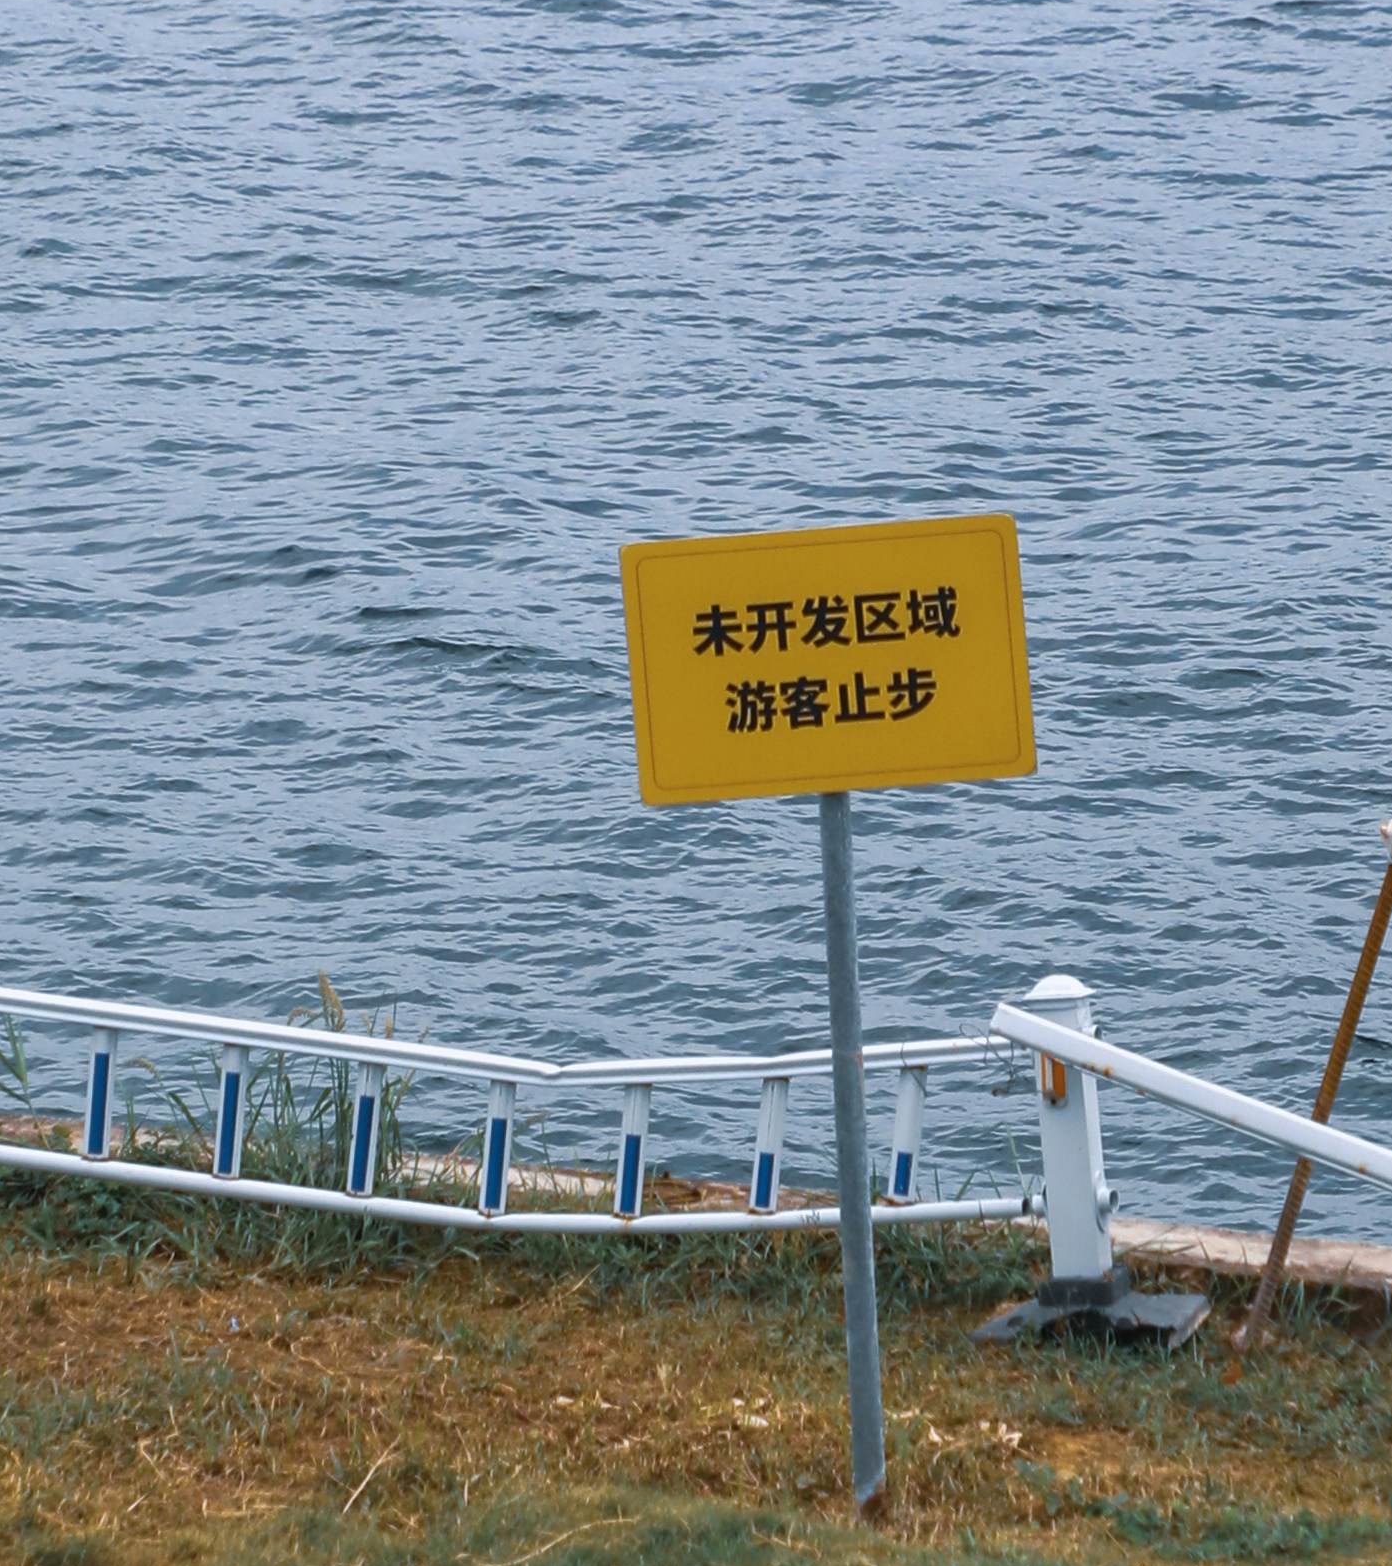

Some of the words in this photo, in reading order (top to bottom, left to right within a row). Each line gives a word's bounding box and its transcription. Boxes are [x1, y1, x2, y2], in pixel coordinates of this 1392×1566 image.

[692, 586, 961, 657] 未开发区域
[725, 667, 937, 733] 游客止步
